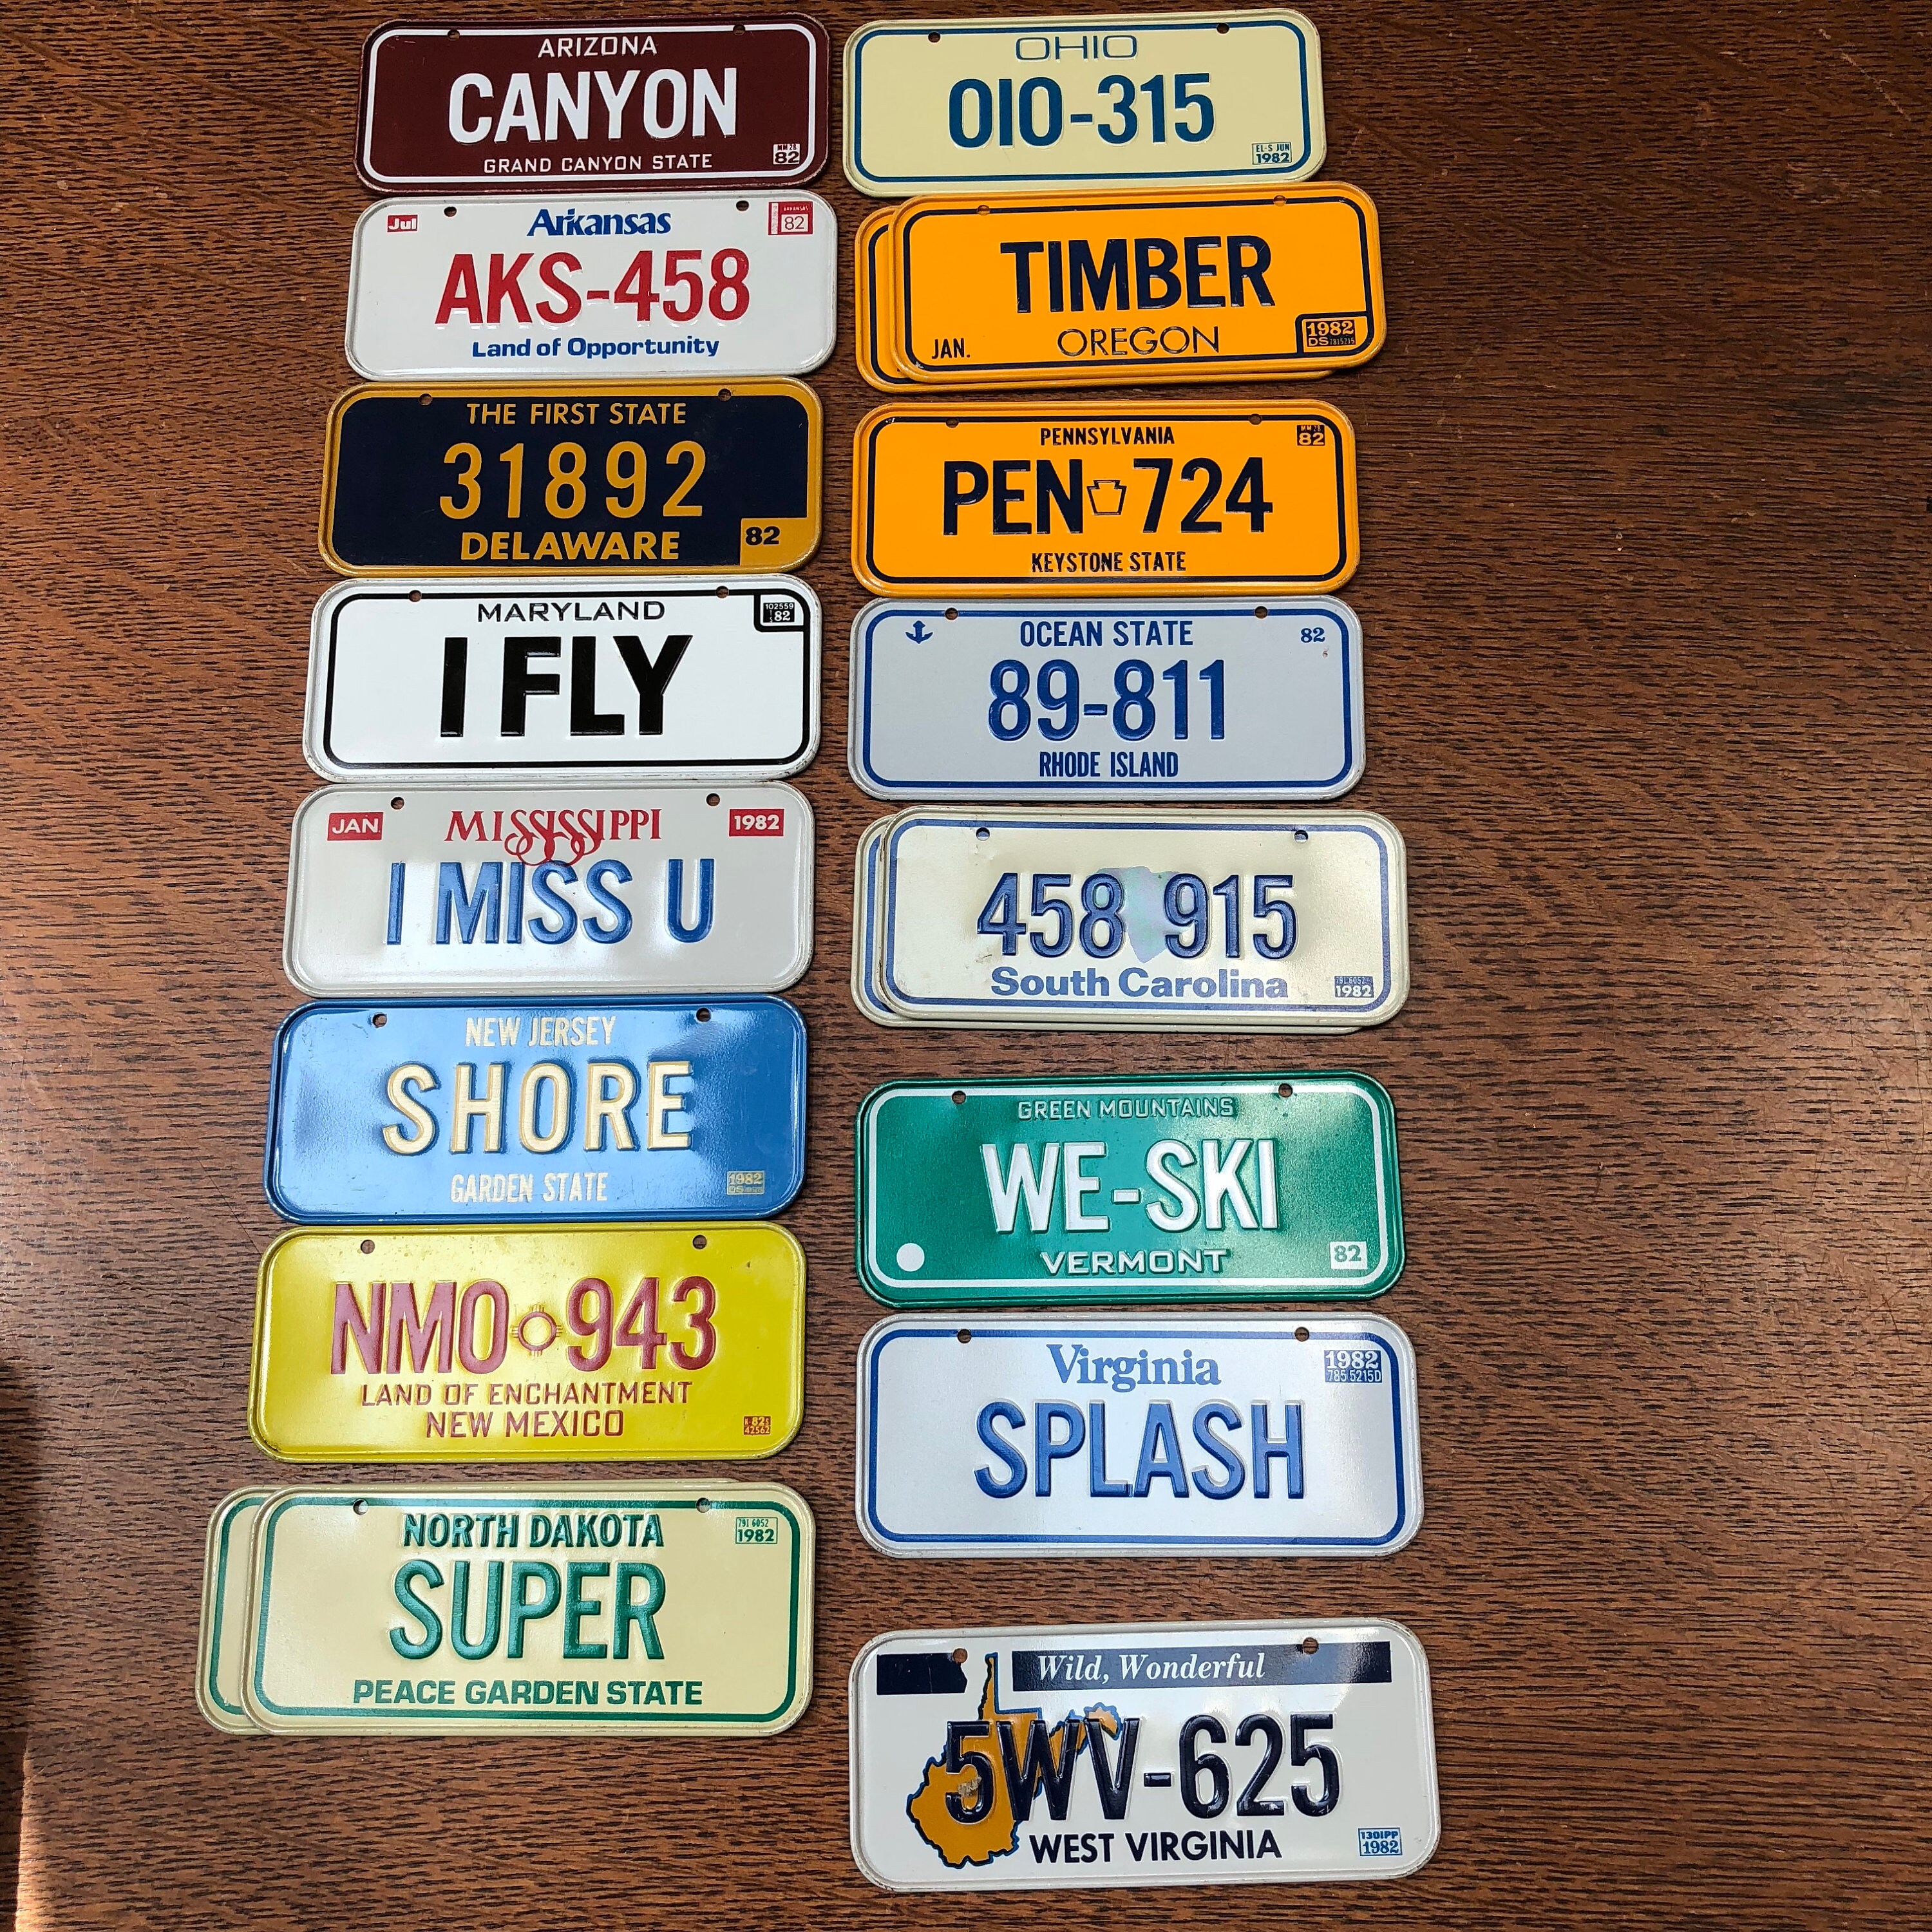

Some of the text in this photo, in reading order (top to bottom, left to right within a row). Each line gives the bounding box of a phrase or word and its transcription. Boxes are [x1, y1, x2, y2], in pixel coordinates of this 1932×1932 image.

[538, 35, 658, 58] ARIZONA
[1015, 35, 1138, 61] OHIO
[450, 68, 737, 143] CANYON
[484, 153, 712, 174] GRAND CANYON STATE
[775, 151, 799, 164] 82
[1256, 153, 1289, 163] 1982
[388, 218, 417, 230] Jul
[527, 209, 672, 236] Arkansas
[784, 216, 804, 230] 82
[435, 249, 750, 325] AKS-458
[1000, 234, 1276, 314] TIMBER
[1057, 325, 1219, 357] OREGON
[1307, 321, 1354, 336] 1982
[1309, 337, 1329, 346] DS
[472, 336, 720, 359] Land of Opportunity
[931, 339, 971, 360] JAN.
[466, 402, 687, 425] THE FIRST STATE
[1039, 426, 1175, 446] PENNSYLVANIA
[1299, 432, 1324, 445] 82
[439, 440, 707, 520] 31892
[943, 457, 1273, 536] PEN 724
[460, 531, 680, 561] DELAWARE
[745, 527, 781, 545] 82
[1031, 551, 1186, 573] KEYSTONE STATE
[478, 601, 665, 623] MARYLAND
[774, 611, 791, 621] 82
[1019, 620, 1193, 647] OCEAN STATE
[1301, 627, 1325, 643] 82
[439, 634, 694, 739] I FLY
[989, 659, 1226, 742] 89-811
[1039, 752, 1179, 778] RHODE ISLAND
[733, 813, 780, 830] 1982
[444, 808, 662, 866] MISSISSIPPI
[386, 858, 715, 945] I MISS U
[977, 873, 1298, 959] 458 915
[991, 966, 1289, 998] South Carolina
[1336, 985, 1372, 996] 1982
[464, 1016, 617, 1046] NEW JERSEY
[382, 1061, 693, 1155] SHORE
[1018, 1098, 1235, 1119] GREEN MOUNTAINS
[450, 1172, 609, 1203] GARDEN STATE
[730, 1173, 762, 1184] 1982
[980, 1139, 1280, 1231] WE-SKI
[1040, 1249, 1229, 1276] VERMONT
[1334, 1246, 1362, 1263] 82
[330, 1275, 717, 1375] NMO 943
[1047, 1343, 1221, 1392] Virginia
[1326, 1350, 1378, 1368] 1982
[361, 1381, 692, 1407] LAND OF ENCHANTMENT
[426, 1411, 623, 1439] NEW MEXICO
[974, 1401, 1305, 1500] SPLASH
[403, 1514, 664, 1548] NORTH DAKOTA
[738, 1528, 774, 1542] 1982
[389, 1560, 665, 1660] SUPER
[1038, 1653, 1265, 1683] Wild, Wonderful
[353, 1681, 703, 1705] PEACE GARDEN STATE
[945, 1714, 1341, 1823] 5WV-625
[1030, 1830, 1282, 1864] WEST VIRGINIA
[1363, 1840, 1399, 1853] 1982
